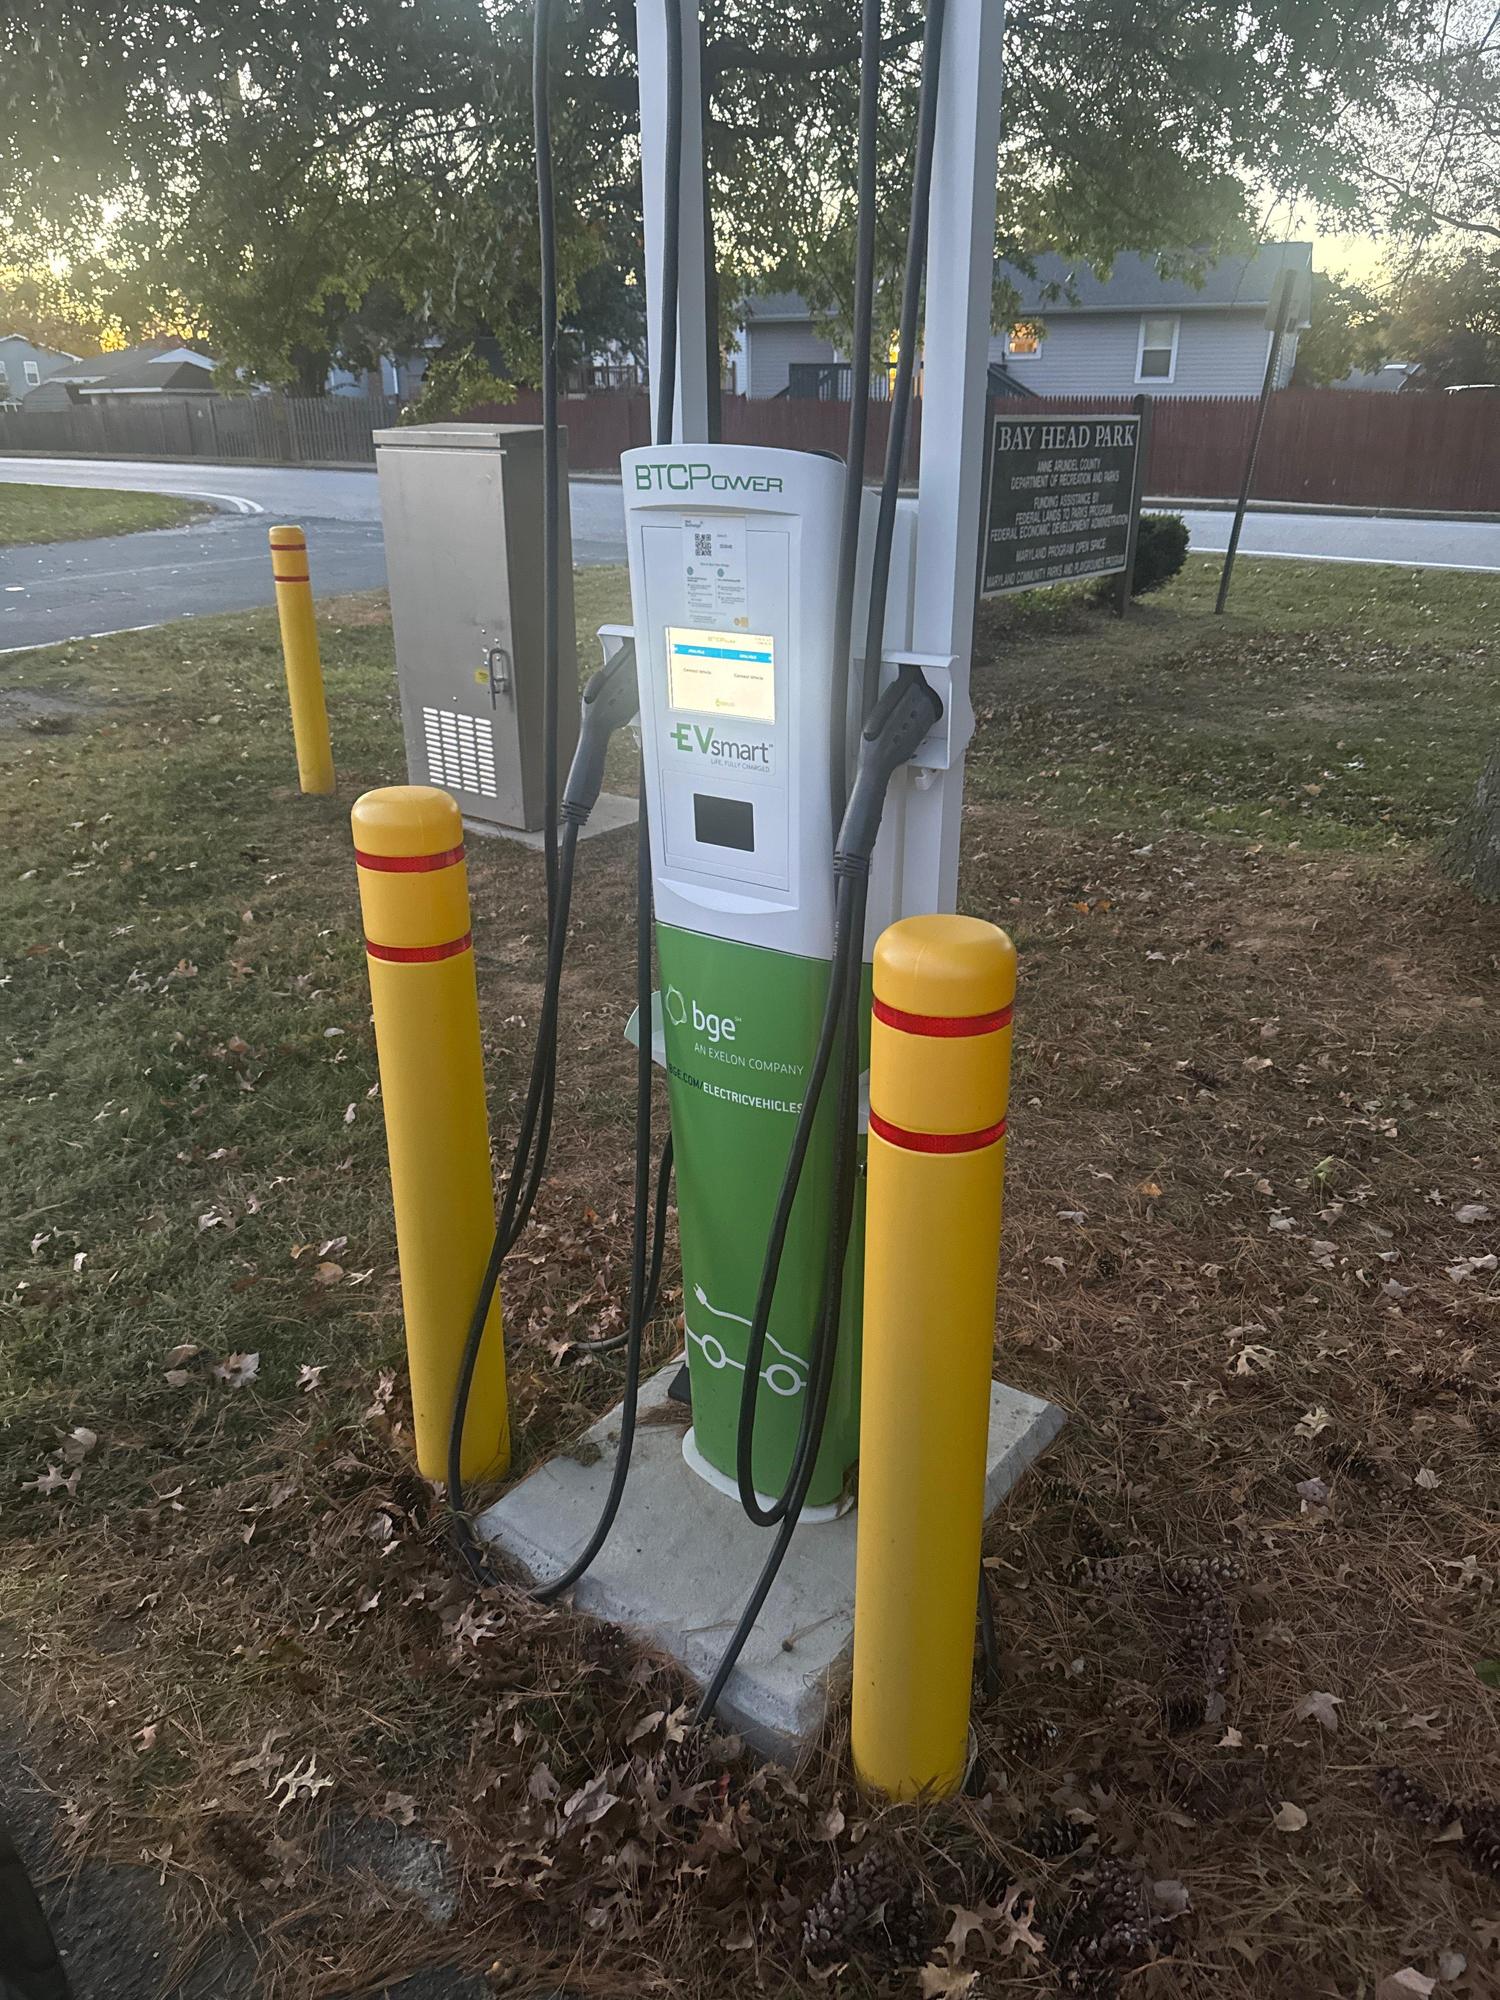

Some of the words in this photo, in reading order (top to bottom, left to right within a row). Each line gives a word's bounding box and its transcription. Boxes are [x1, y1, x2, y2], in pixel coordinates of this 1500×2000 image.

[998, 426, 1036, 451] BAY
[1040, 426, 1090, 450] HEAD
[1095, 425, 1135, 447] PARK
[1037, 459, 1053, 472] ANNE
[1054, 459, 1078, 471] ARUNDEL
[1080, 458, 1101, 470] COUNTY
[1010, 475, 1048, 490] DEPARTMENT
[1049, 474, 1058, 487] OF
[1059, 473, 1091, 486] RECREATION
[1092, 472, 1103, 483] AND
[1104, 471, 1120, 482] PARKS
[1034, 495, 1059, 509] FUNDING
[1060, 493, 1091, 506] ASSISTANCE
[1092, 492, 1099, 503] BY
[1015, 511, 1041, 525] FEDERAL
[1042, 508, 1061, 522] LANDS
[1063, 508, 1070, 519] TO
[1071, 506, 1088, 518] PARKS
[1089, 504, 1113, 516] PROGRAM
[990, 528, 1018, 542] FEDERAL
[1019, 523, 1050, 538] ECONOMIC
[1052, 519, 1090, 535] DEVELOPMENT
[1091, 514, 1129, 529] ADMINISTRATION
[1016, 546, 1047, 562] MARYLAND
[1048, 543, 1075, 558] PROGRAM
[1075, 540, 1089, 553] OPEN
[1090, 538, 1107, 551] SPACE
[986, 572, 1015, 588] MARYLAND
[1016, 568, 1046, 584] COMMUNITY
[1047, 565, 1062, 578] PARKS
[1063, 564, 1073, 576] AND
[742, 763, 770, 772] CHARGED
[692, 1000, 736, 1042] bge
[694, 1043, 706, 1054] AN
[708, 1048, 746, 1066] EXELON
[748, 1058, 804, 1075] COMPANY
